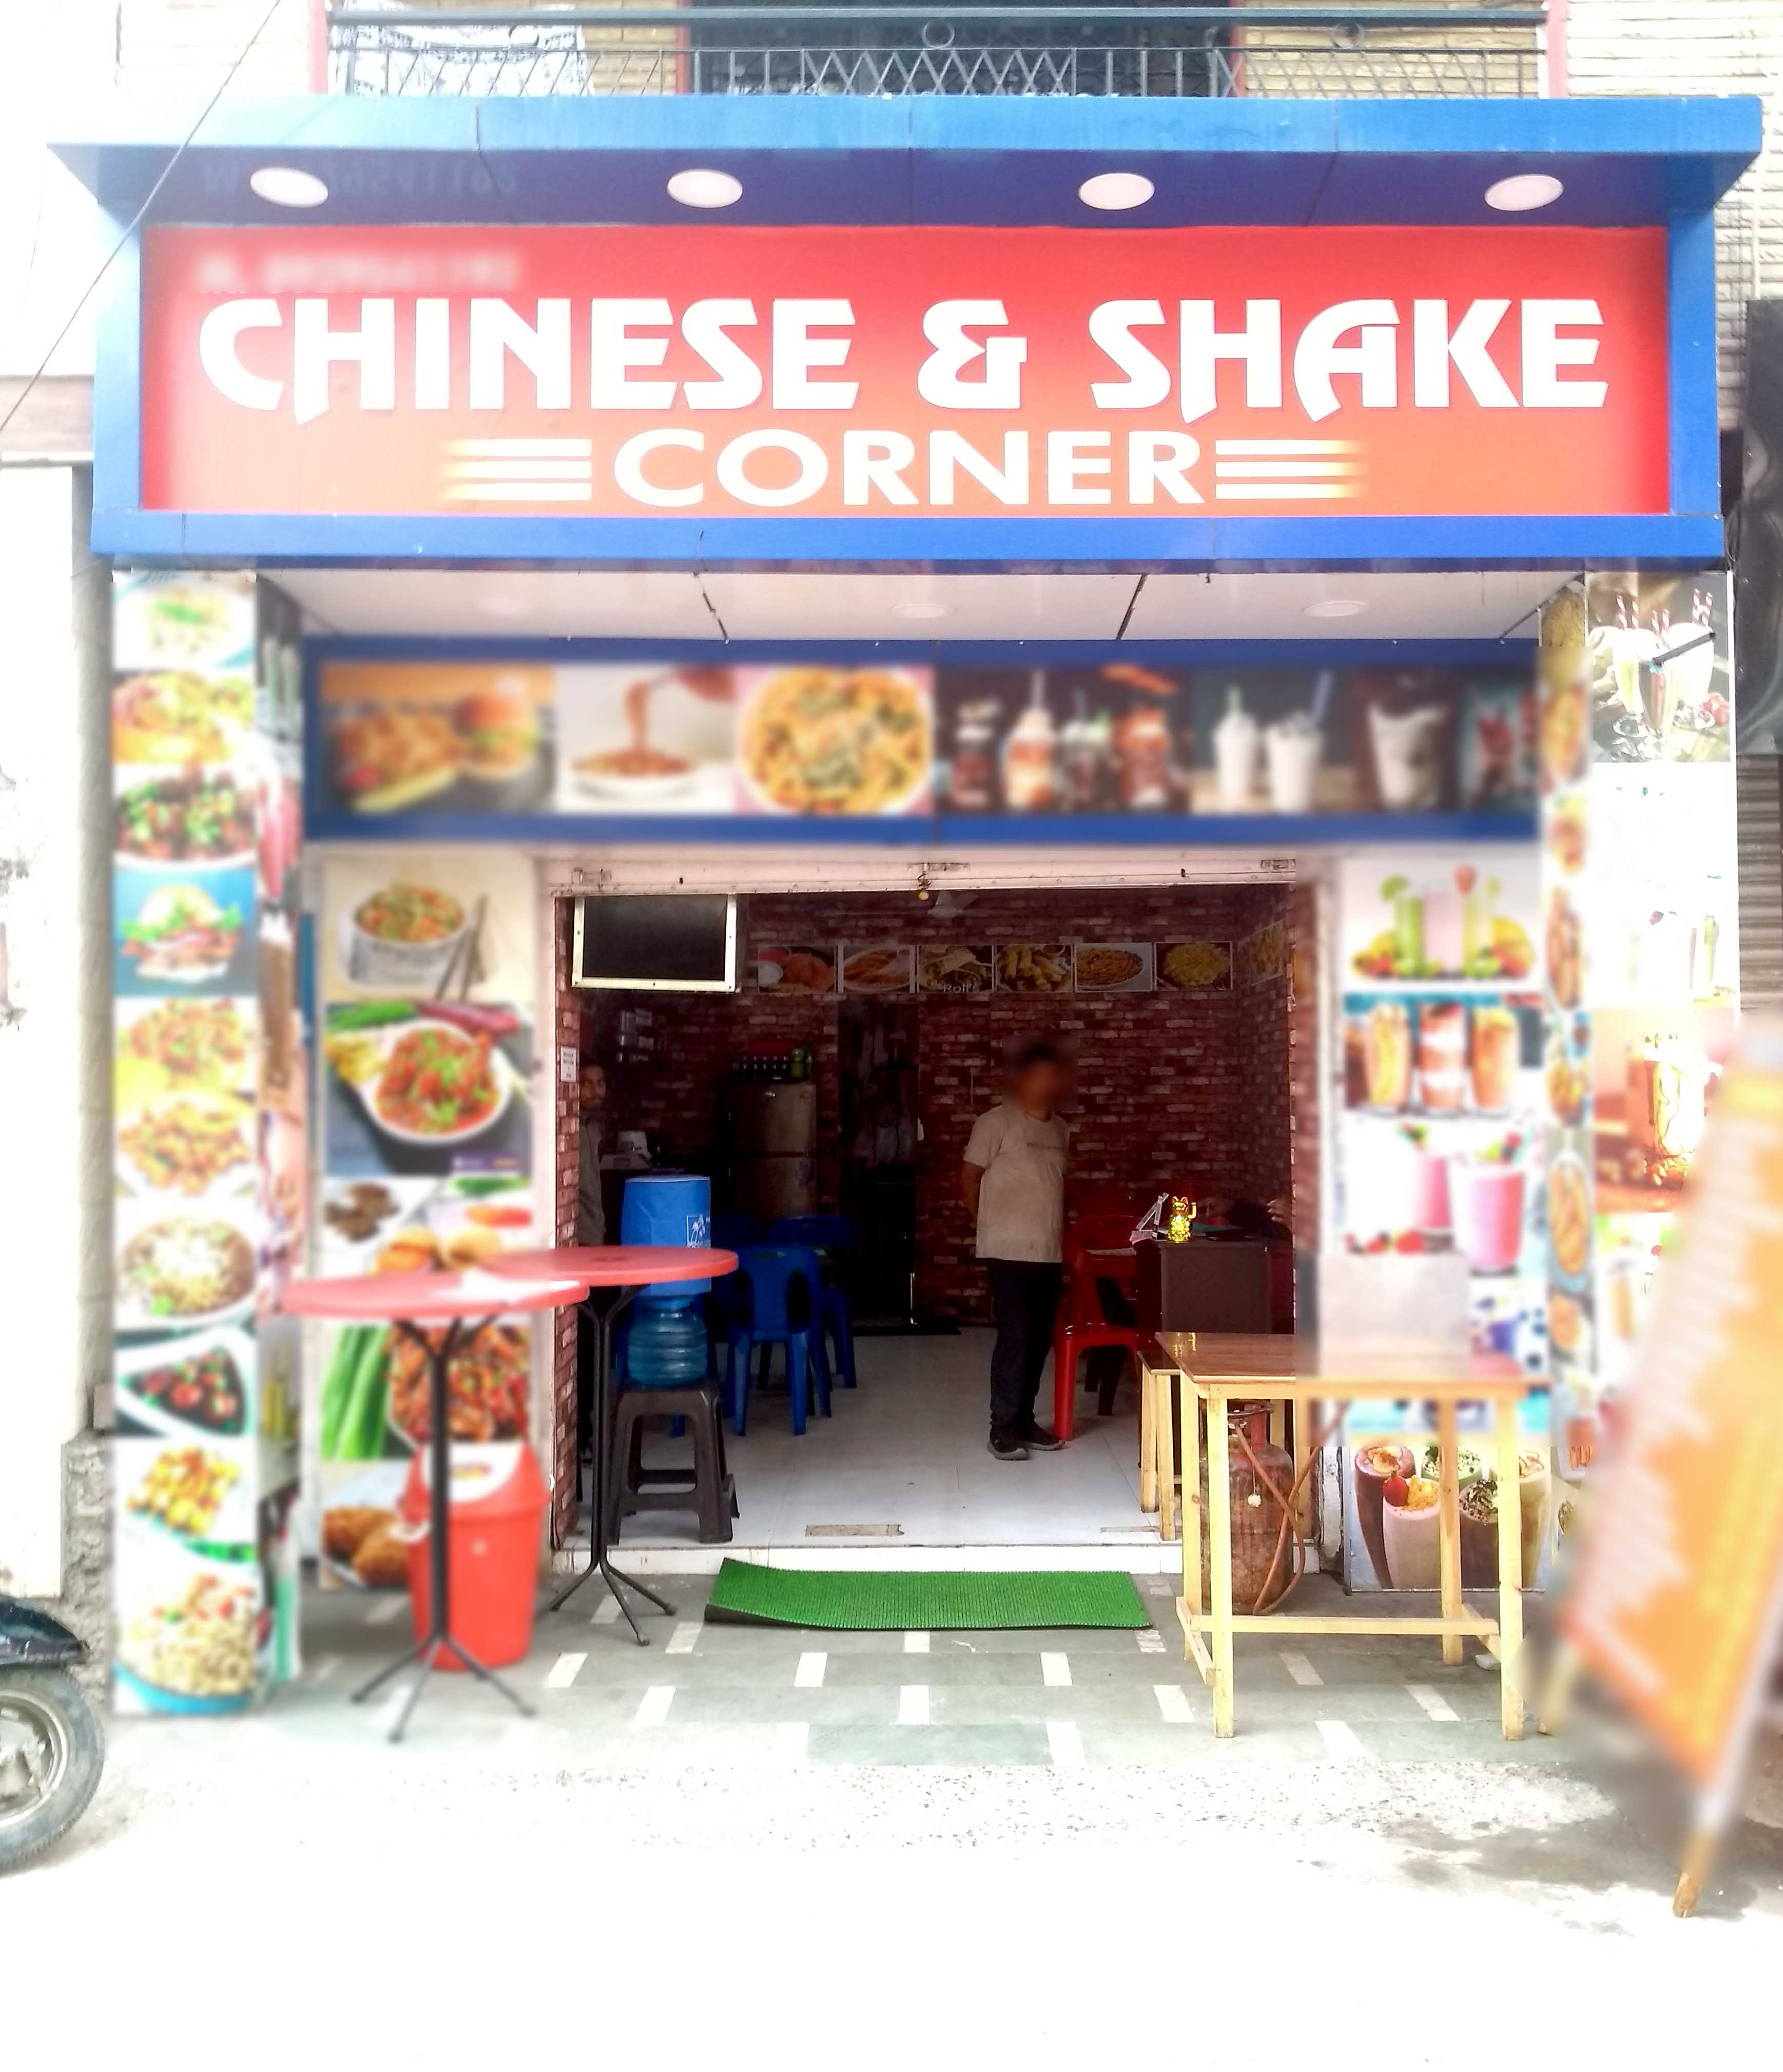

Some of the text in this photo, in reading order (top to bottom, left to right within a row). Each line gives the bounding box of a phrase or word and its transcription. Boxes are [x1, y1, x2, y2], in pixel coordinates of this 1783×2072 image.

[198, 298, 1609, 428] CHINESE & SHAKE
[613, 428, 1206, 508] CORNER
